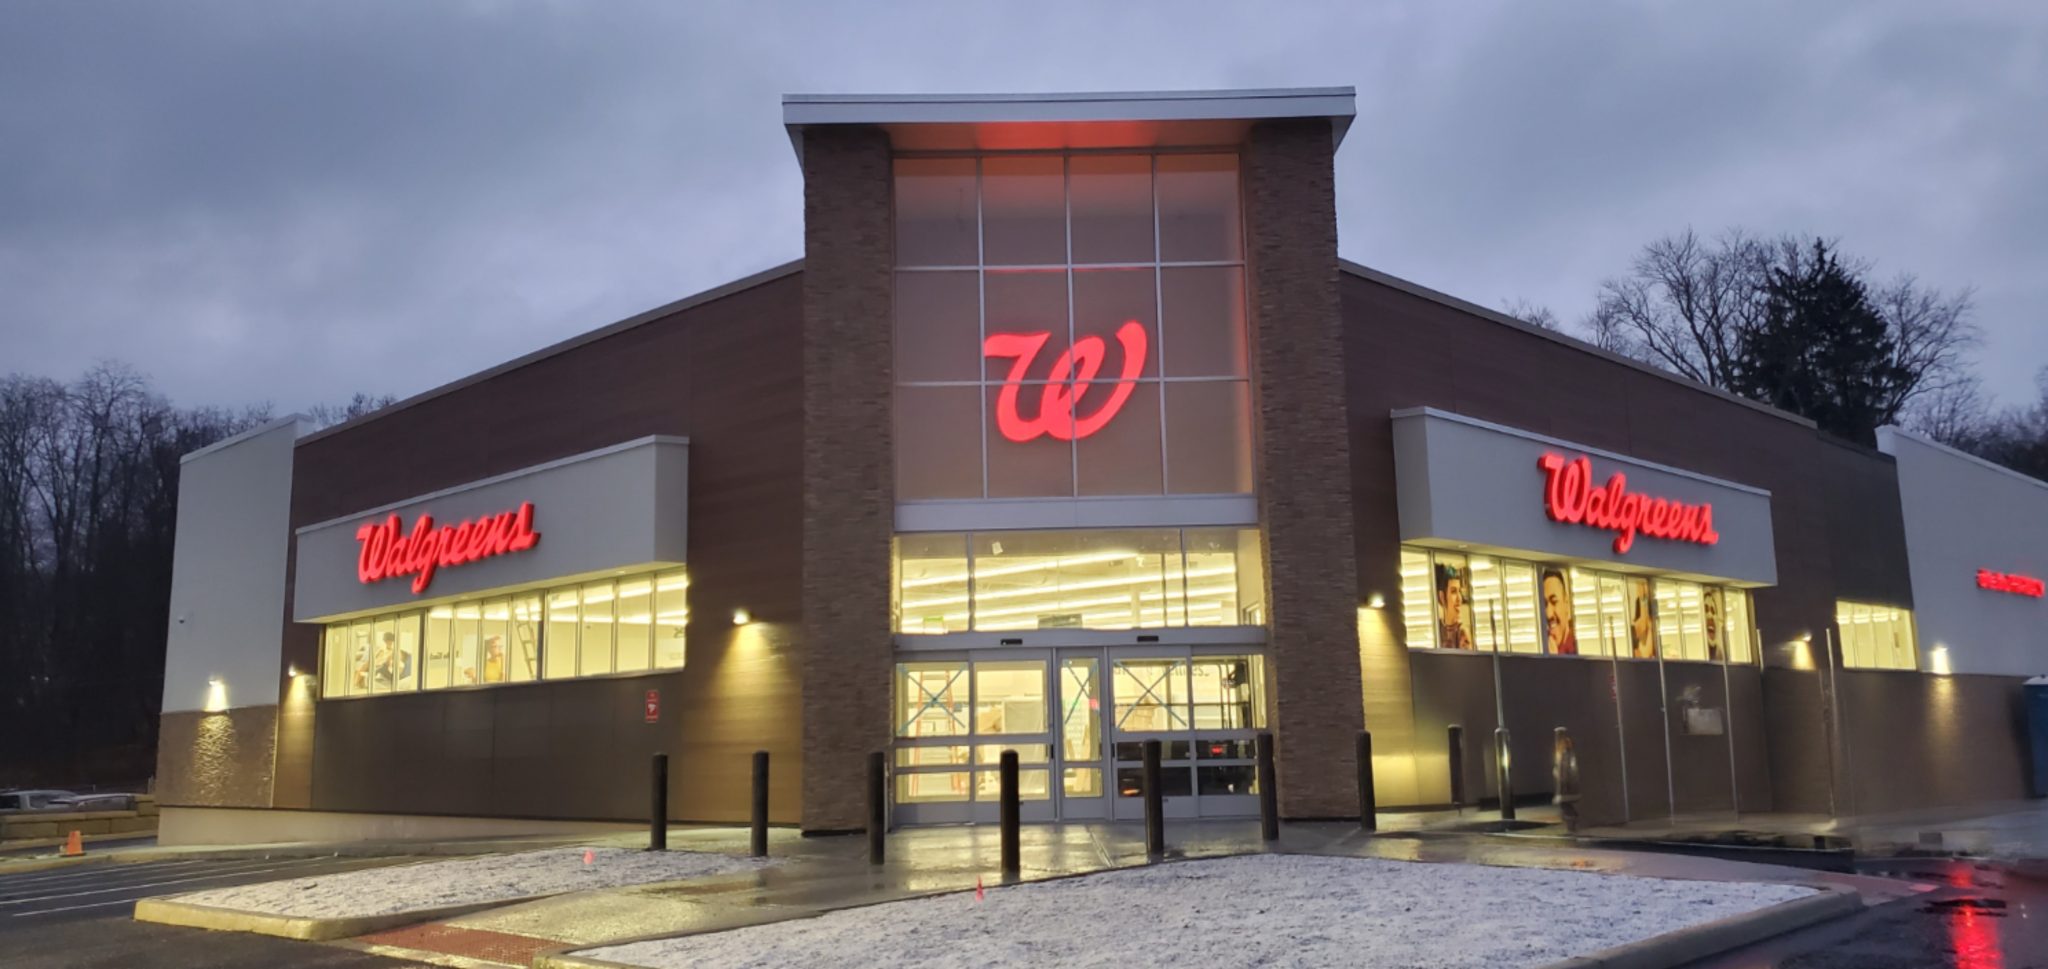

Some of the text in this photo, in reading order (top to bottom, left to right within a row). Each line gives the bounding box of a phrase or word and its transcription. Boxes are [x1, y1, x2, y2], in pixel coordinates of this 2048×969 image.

[984, 319, 1148, 443] W
[356, 501, 540, 594] Walgreens
[1538, 452, 1719, 554] Walgreens
